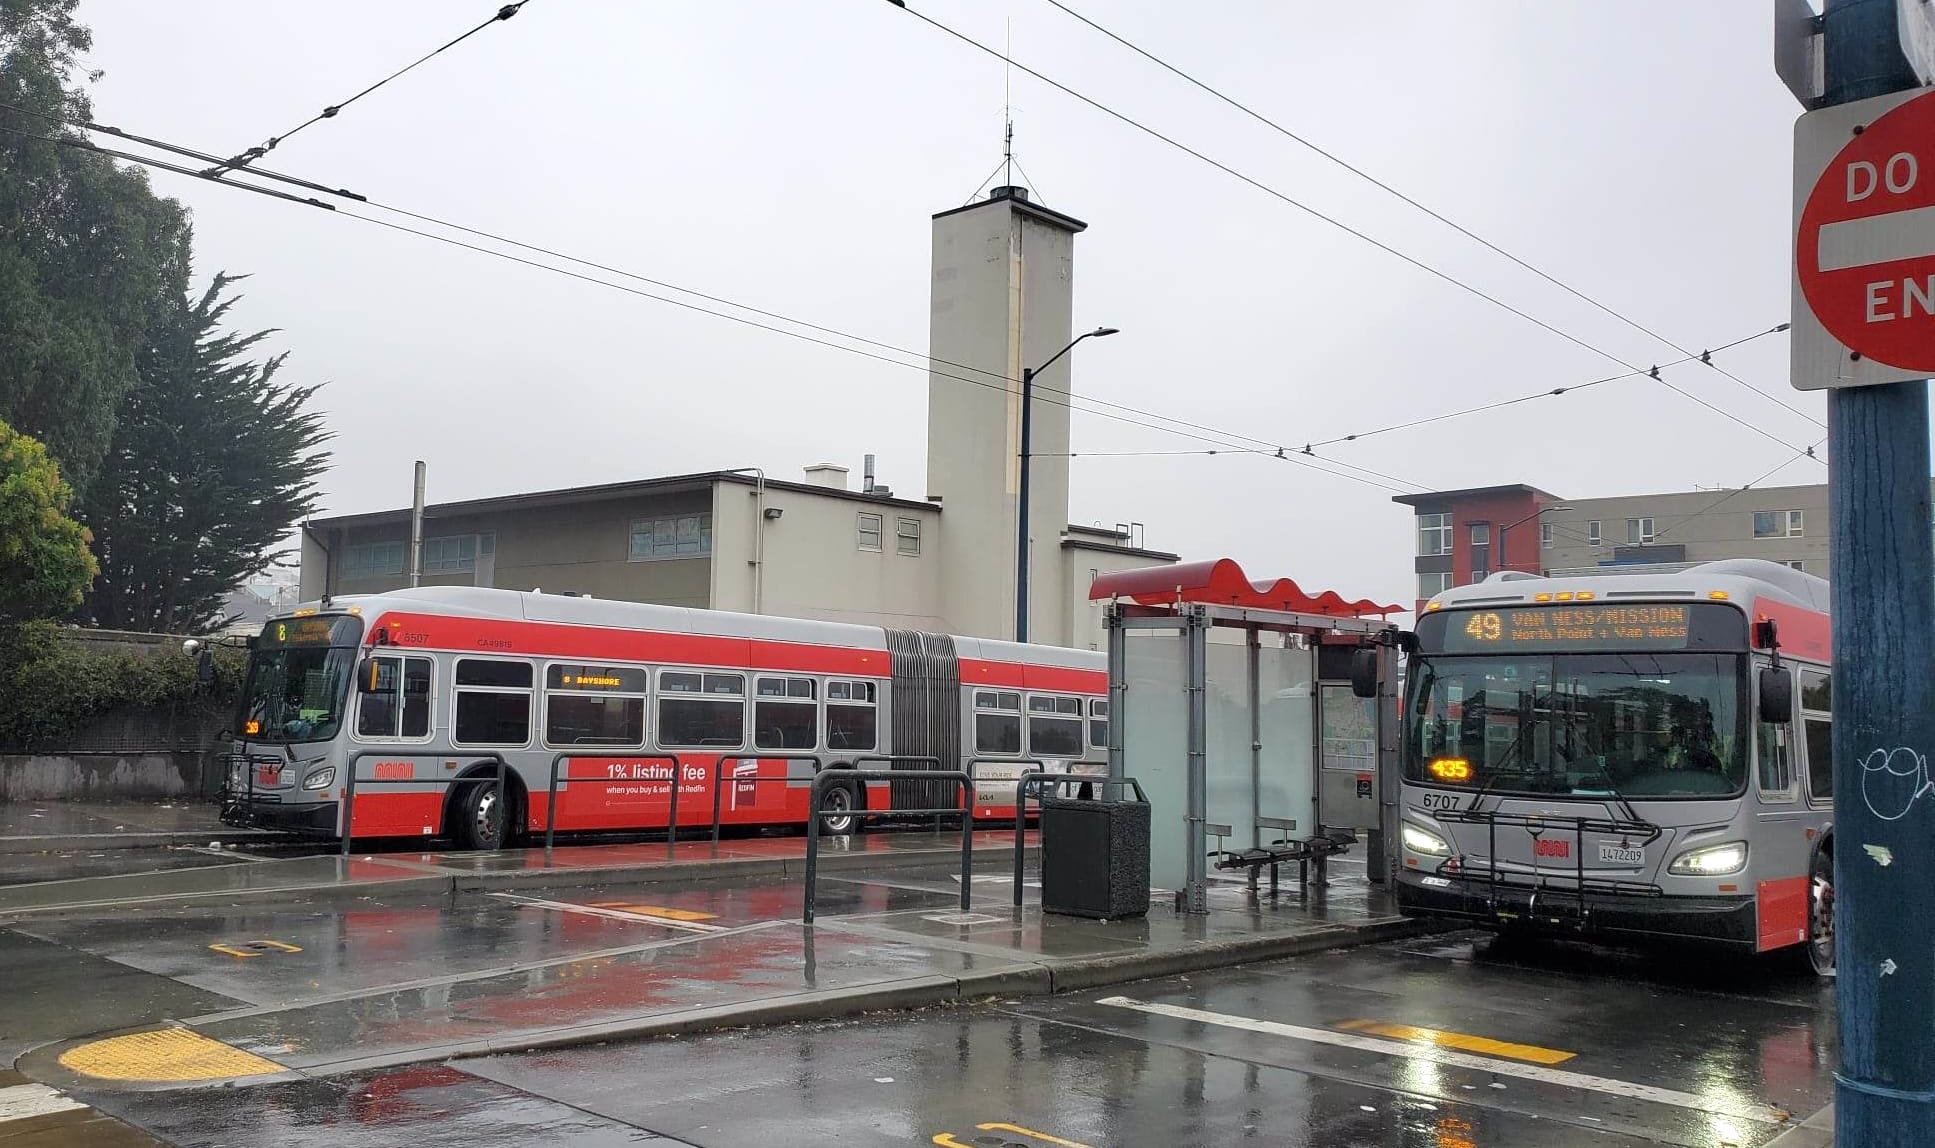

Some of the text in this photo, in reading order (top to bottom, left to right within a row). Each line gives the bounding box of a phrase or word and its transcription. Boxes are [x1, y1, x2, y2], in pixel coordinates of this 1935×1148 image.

[1846, 152, 1918, 202] DO
[279, 624, 286, 641] 8
[1465, 613, 1501, 640] 49
[576, 676, 620, 686] BAYSHORE
[607, 764, 627, 779] 1%
[683, 763, 706, 780] fee
[1432, 760, 1468, 778] 435
[607, 785, 624, 794] when
[627, 786, 639, 795] you
[640, 785, 651, 795] buy
[1423, 793, 1460, 810] 6707
